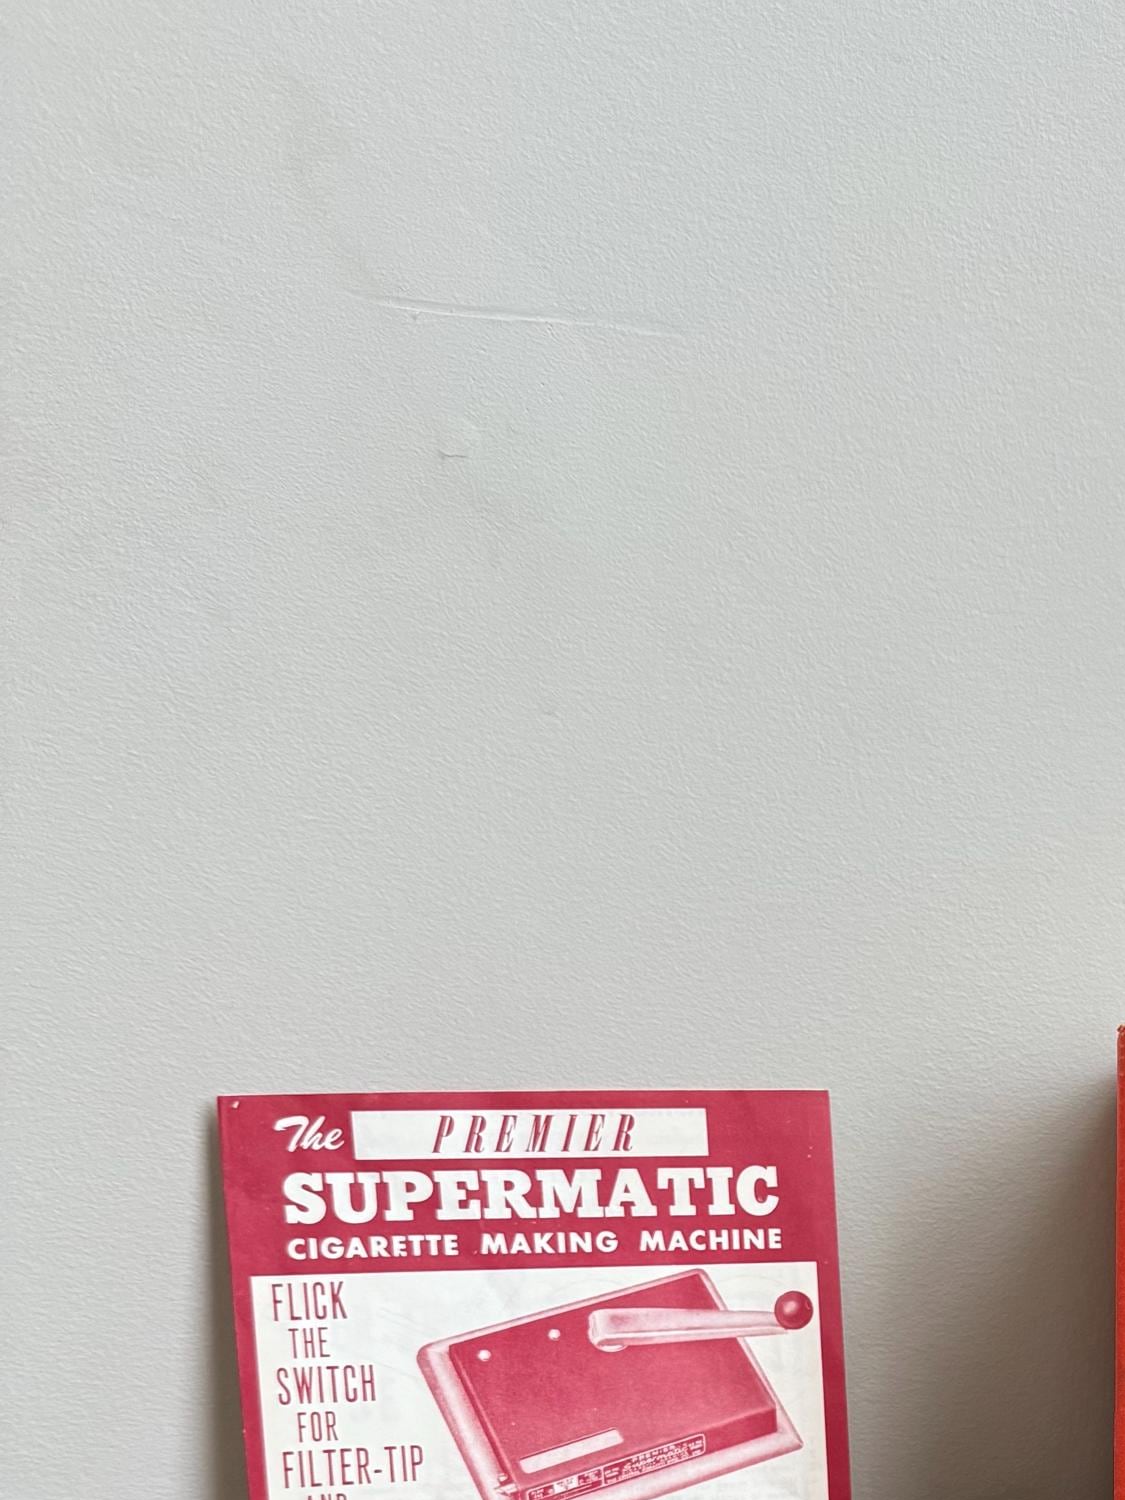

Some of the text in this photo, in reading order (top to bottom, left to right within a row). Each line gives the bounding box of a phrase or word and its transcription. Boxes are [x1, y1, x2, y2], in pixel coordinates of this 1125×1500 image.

[274, 1113, 637, 1154] The PREMIER
[282, 1165, 780, 1225] SUPERMATIC
[286, 1227, 783, 1261] CIGARETTE MAKING MACHINE
[271, 1281, 348, 1322] FLICK
[287, 1326, 331, 1359] THE
[276, 1364, 377, 1405] SWITCH
[297, 1411, 339, 1443] FOR
[282, 1444, 425, 1489] FILTER-TIP
